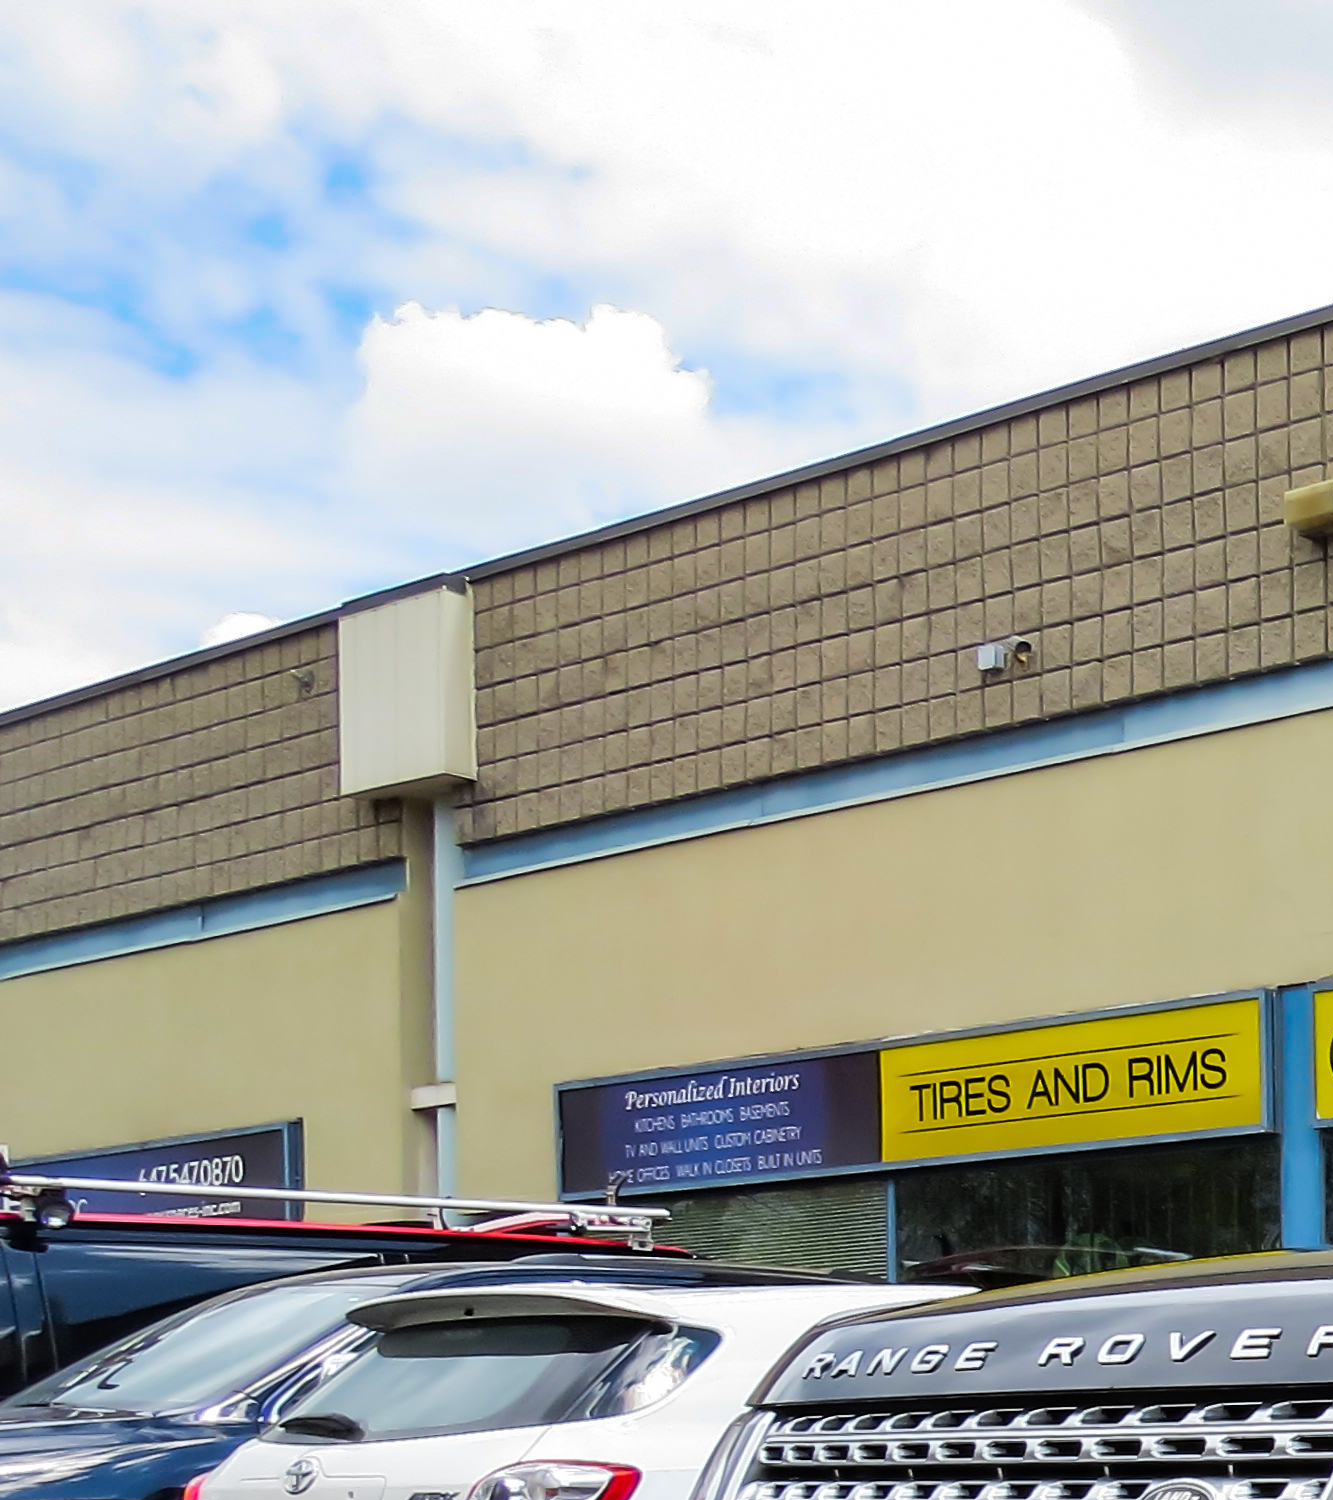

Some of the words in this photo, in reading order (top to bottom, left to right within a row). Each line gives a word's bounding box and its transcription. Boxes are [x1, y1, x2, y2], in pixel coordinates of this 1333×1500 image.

[624, 1075, 728, 1111] Personalized
[728, 1072, 800, 1098] Interiors
[909, 1074, 1011, 1122] TIRES
[1026, 1062, 1109, 1110] AND
[1127, 1048, 1227, 1099] RIMS
[634, 1115, 675, 1133] KITCHENS
[681, 1108, 734, 1129] BATHROOMS
[739, 1101, 790, 1121] BASEMENTS
[625, 1144, 635, 1158] TV
[638, 1141, 658, 1157] AND
[714, 1132, 751, 1149] CUSTOM
[754, 1126, 802, 1145] CABINETRY
[637, 1165, 670, 1182] OFFICES
[715, 1156, 752, 1175] CLOSETS
[758, 1153, 780, 1170] BUILT
[796, 1149, 823, 1166] UNITS
[801, 1341, 997, 1380] RANGE
